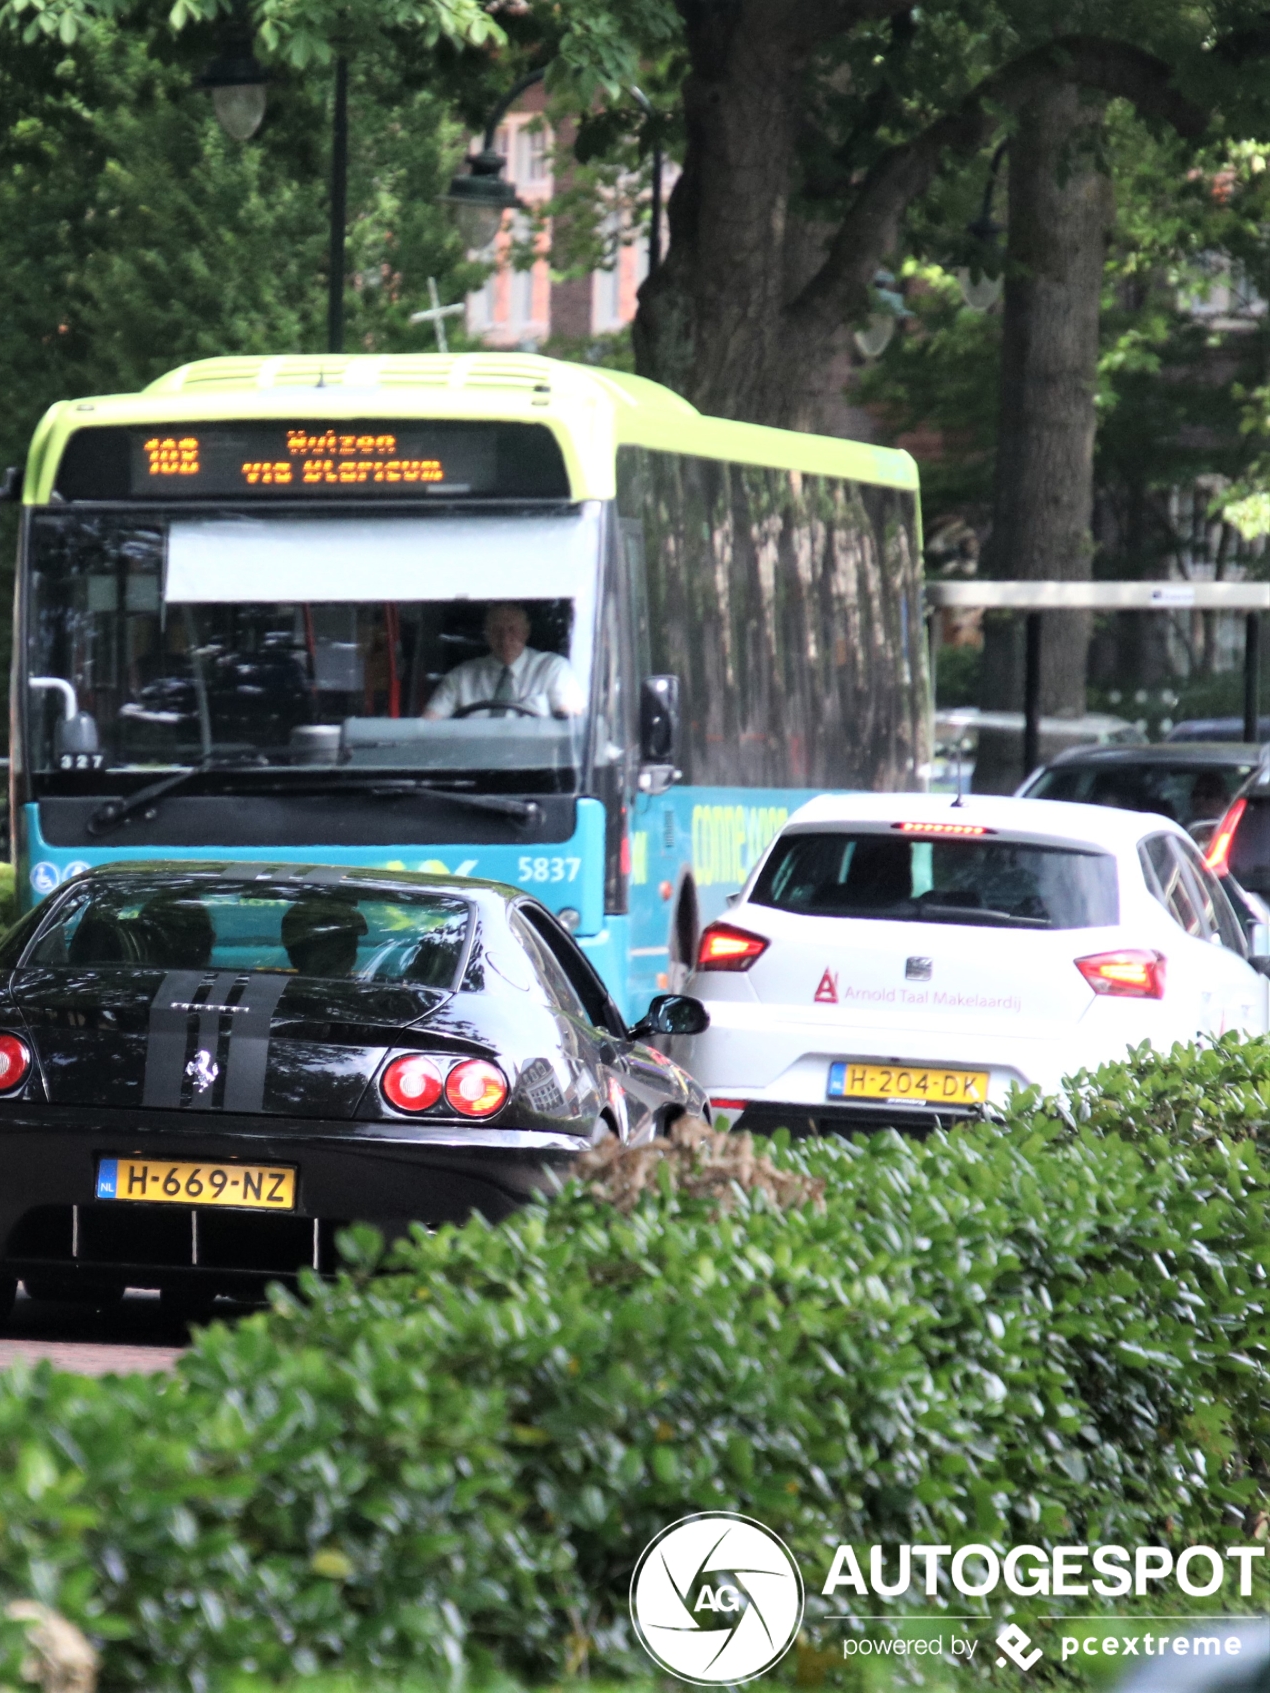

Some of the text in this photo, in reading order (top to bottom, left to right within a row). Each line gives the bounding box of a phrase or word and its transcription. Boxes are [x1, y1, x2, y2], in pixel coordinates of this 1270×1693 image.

[242, 462, 292, 483] via
[60, 754, 104, 769] 327
[518, 856, 580, 882] 5837
[845, 986, 1023, 1013] Arnold Taal Makelaardij
[850, 1069, 979, 1098] H-204-DK
[100, 1183, 114, 1193] NL
[128, 1166, 286, 1202] H-669-NZ
